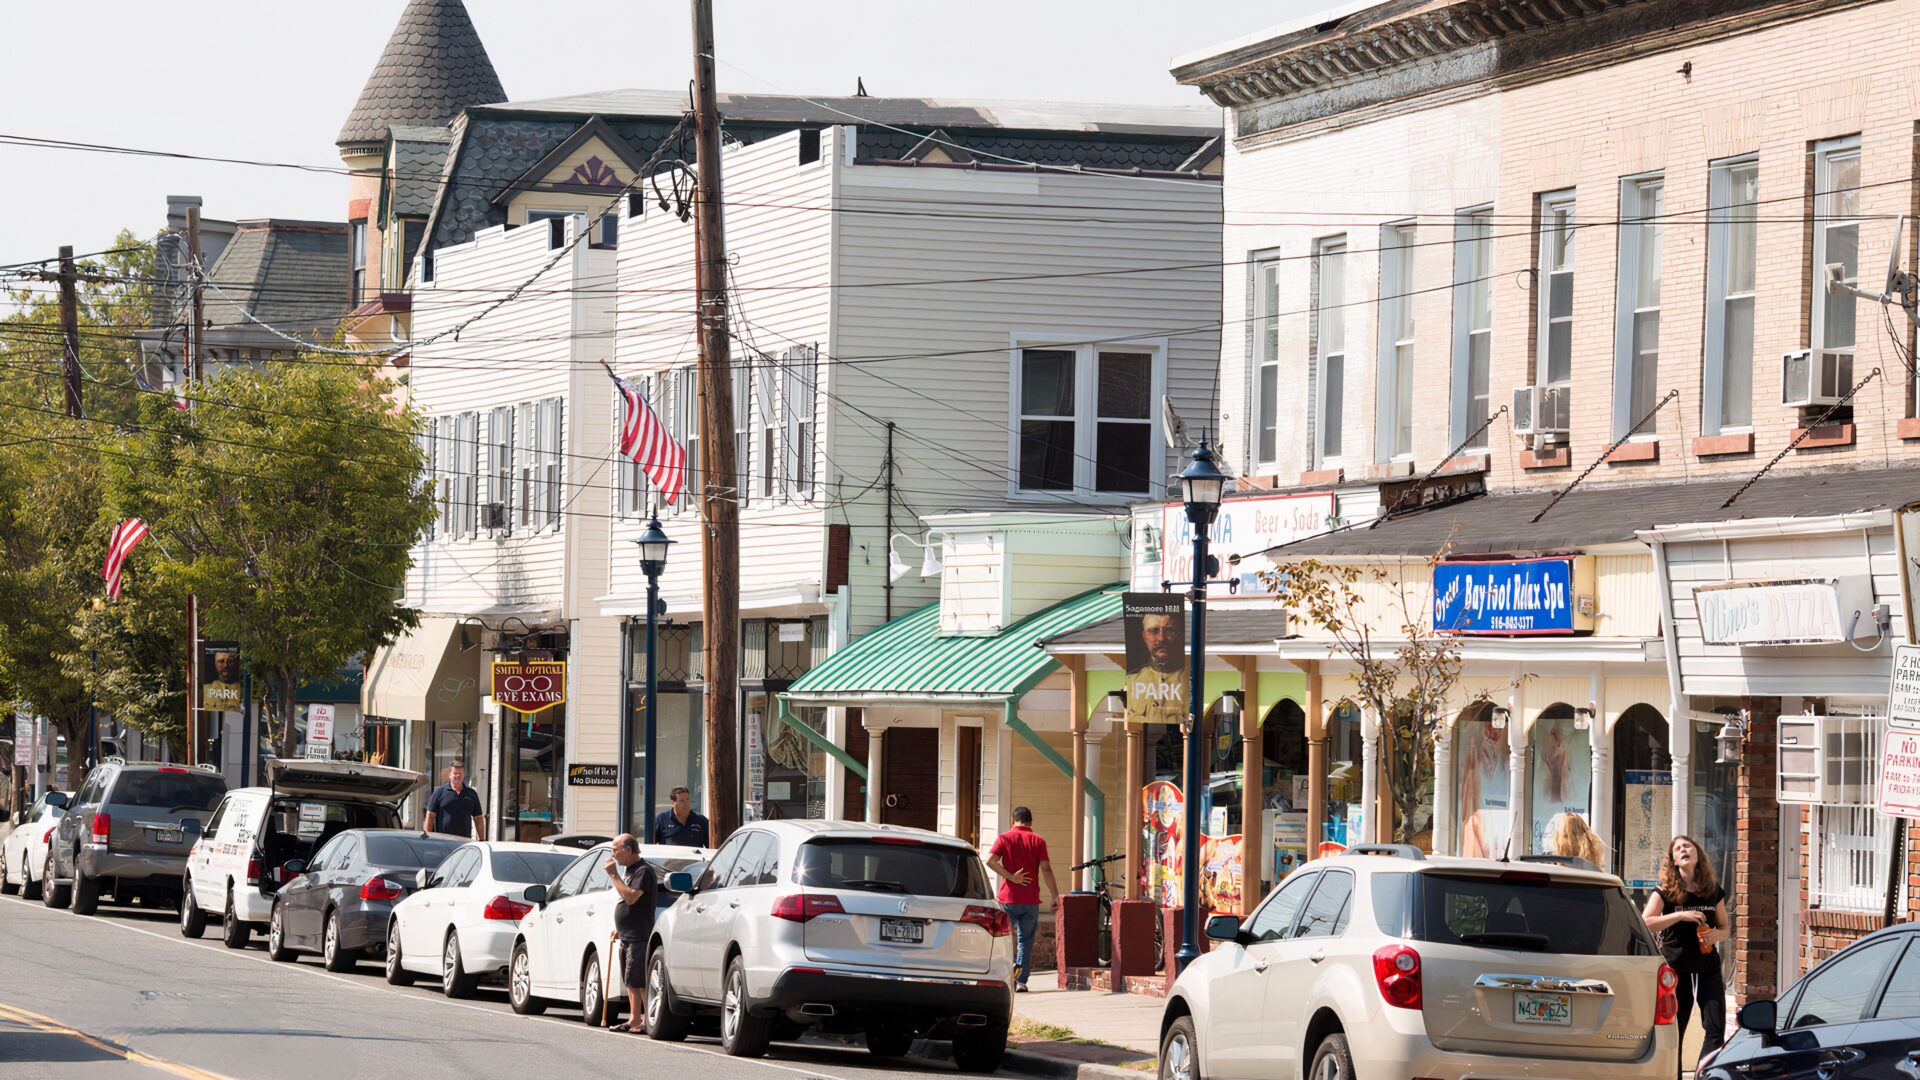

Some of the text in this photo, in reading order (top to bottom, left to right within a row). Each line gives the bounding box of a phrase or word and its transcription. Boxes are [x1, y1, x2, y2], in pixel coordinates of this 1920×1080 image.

[1255, 503, 1319, 534] Beer Soda
[1465, 574, 1486, 620] Bay
[1487, 574, 1511, 610] Foot
[1513, 571, 1541, 611] Relax
[1543, 572, 1565, 619] Spa
[1767, 590, 1839, 638] PIZZA
[1901, 655, 1908, 668] 2
[495, 666, 562, 675] SMITH OPTICAL
[208, 688, 238, 700] PARK
[496, 691, 562, 702] EYE EXAMS
[1901, 740, 1917, 754] NO
